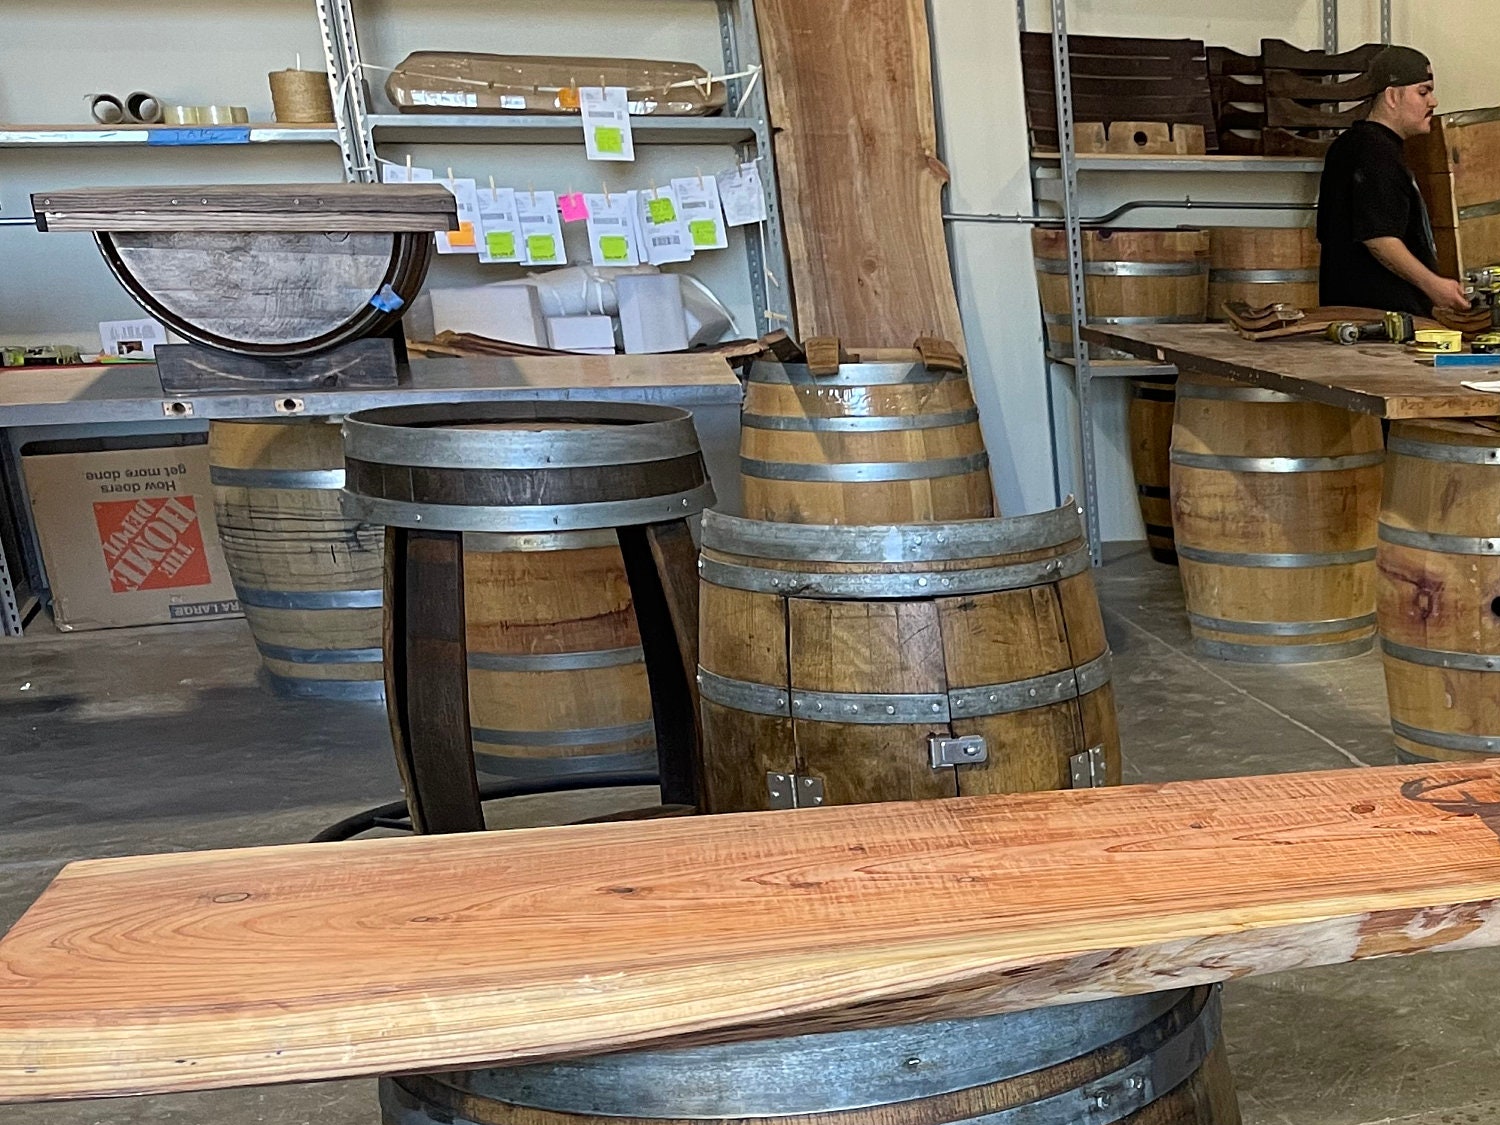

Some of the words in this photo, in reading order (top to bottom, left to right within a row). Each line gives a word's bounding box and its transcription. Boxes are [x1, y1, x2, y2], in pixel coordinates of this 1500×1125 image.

[125, 467, 161, 478] more
[166, 463, 187, 477] get
[100, 482, 141, 494] doers
[144, 480, 176, 492] How
[102, 499, 156, 559] DEPOT
[109, 497, 197, 592] HOME
[158, 541, 195, 578] THE
[174, 603, 219, 617] LARGE
[221, 600, 243, 612] RA
